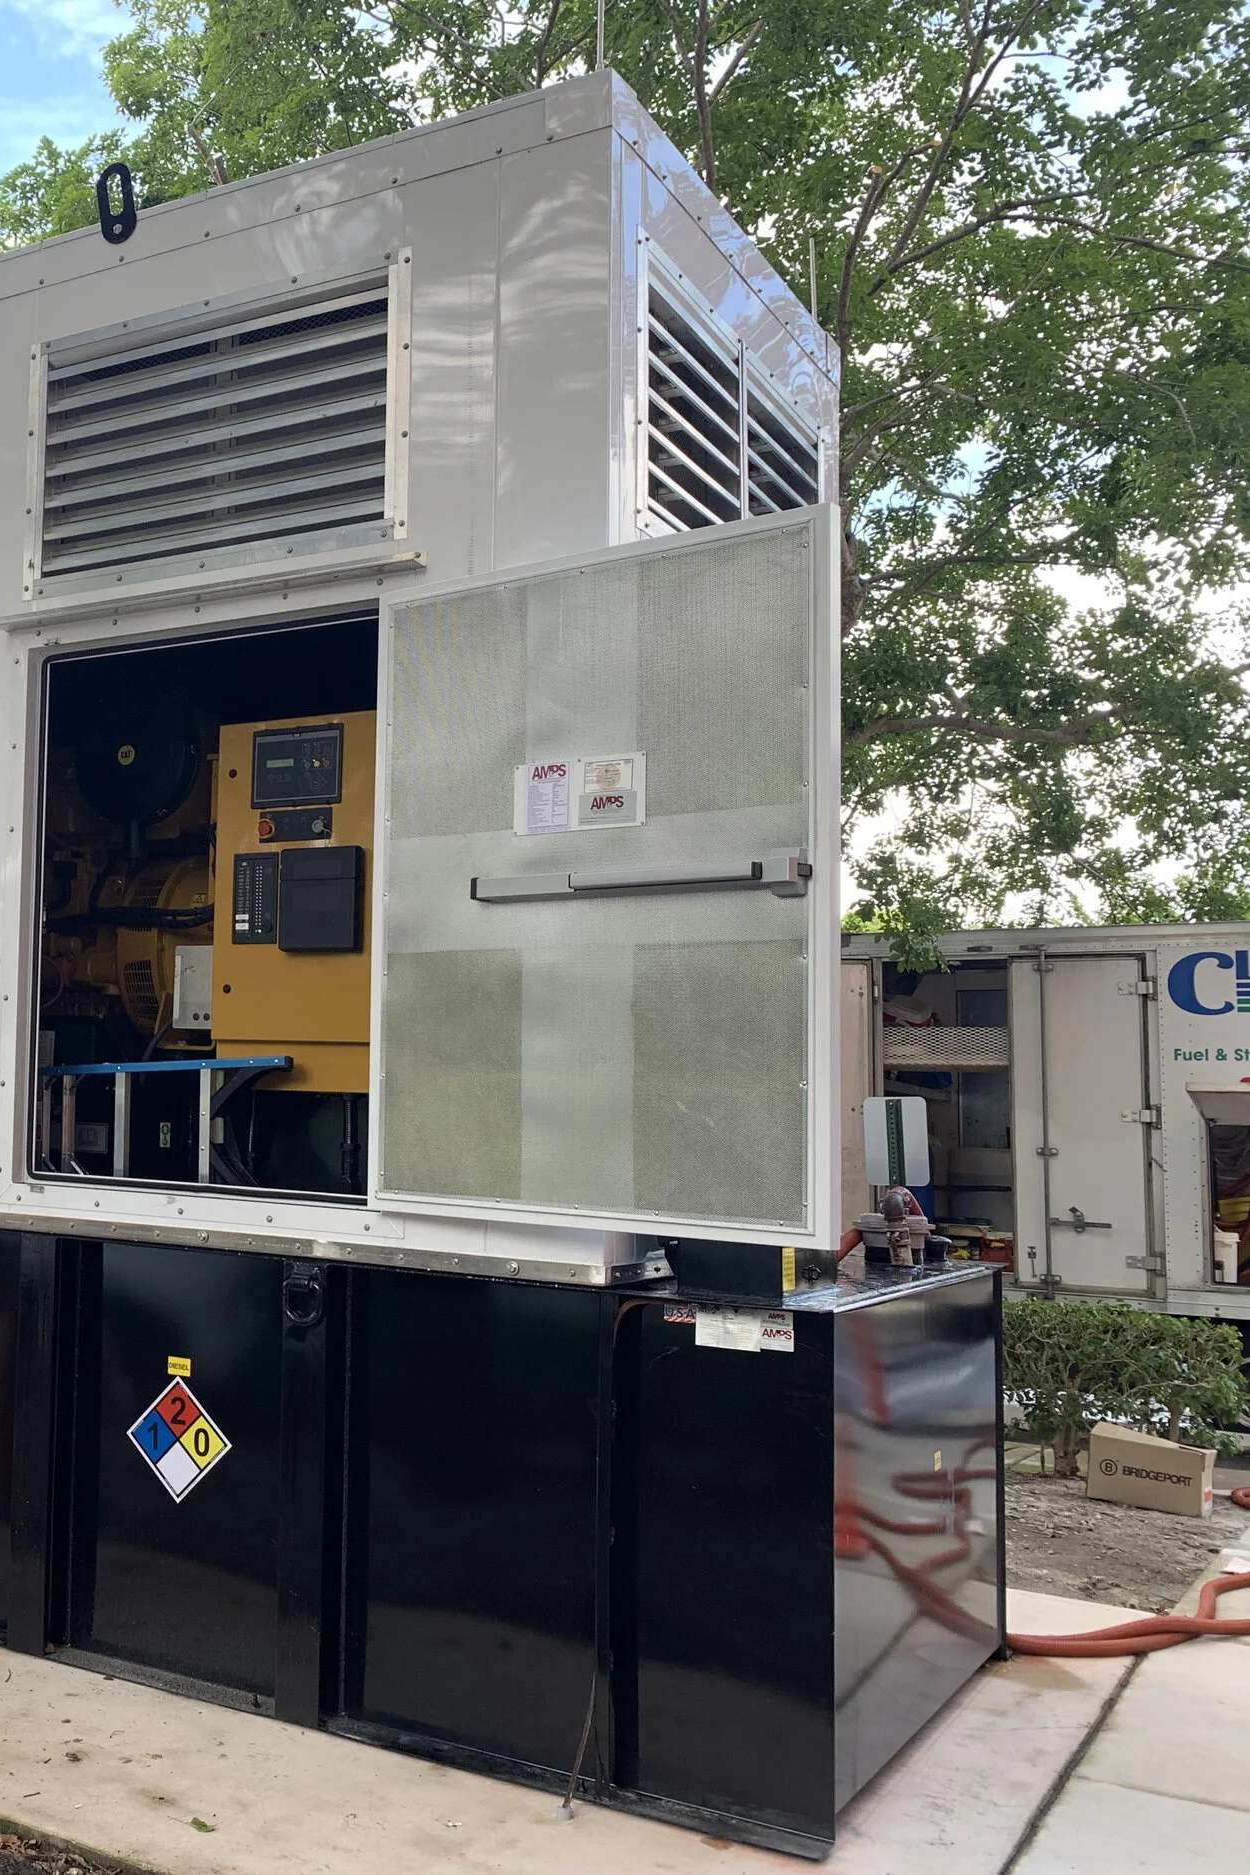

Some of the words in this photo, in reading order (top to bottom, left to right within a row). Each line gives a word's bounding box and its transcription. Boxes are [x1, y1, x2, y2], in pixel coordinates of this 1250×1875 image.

[121, 751, 132, 759] CAT
[1174, 1048, 1209, 1061] Fuel
[1216, 1048, 1227, 1061] &
[169, 1362, 189, 1371] DIESEL
[170, 1397, 186, 1426] 2
[147, 1422, 159, 1451] 1
[194, 1428, 210, 1457] 0
[1122, 1465, 1193, 1487] BRIDGEPORT
